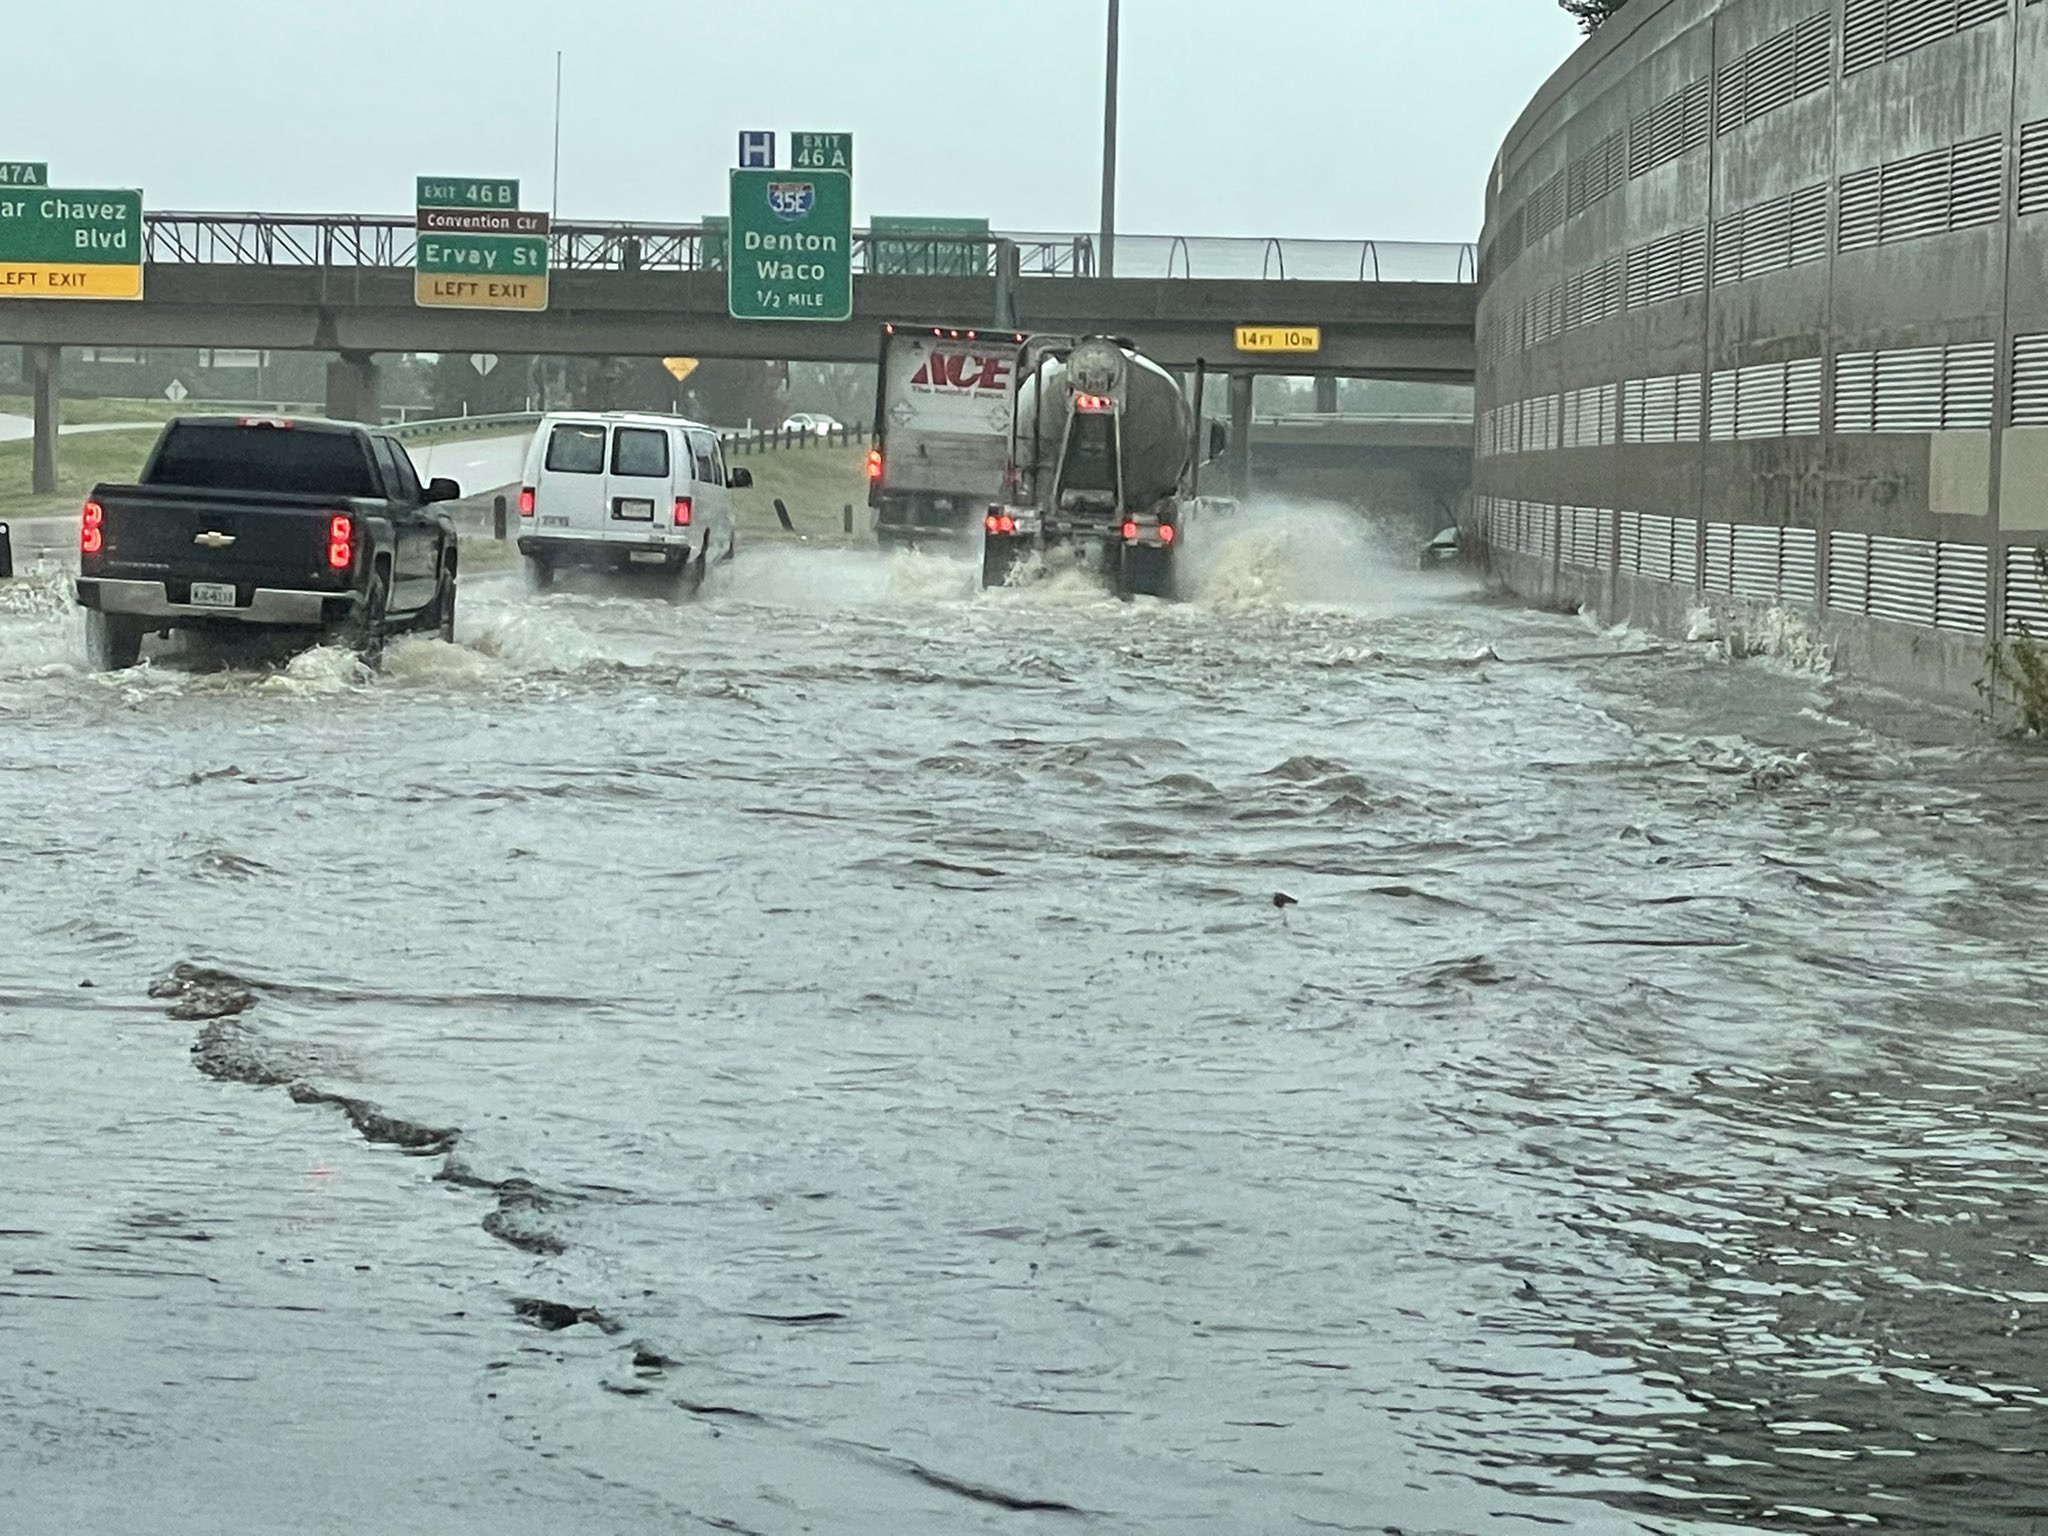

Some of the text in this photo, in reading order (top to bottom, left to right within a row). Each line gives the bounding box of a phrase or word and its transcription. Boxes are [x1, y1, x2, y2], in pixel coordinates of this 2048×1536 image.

[743, 133, 771, 167] H
[802, 135, 840, 148] EXIT
[797, 149, 846, 167] 46 A
[424, 185, 512, 203] EXIT 46 B
[772, 190, 807, 213] 35E
[40, 199, 127, 220] Chavez
[427, 213, 538, 229] Convention Ctr
[75, 228, 126, 248] Blvd
[745, 231, 837, 252] Denton
[425, 244, 538, 270] Ervay St
[48, 272, 87, 287] EXIT
[757, 261, 825, 280] Waco
[434, 281, 528, 298] LEFT EXIT
[788, 293, 823, 306] MILE
[910, 352, 1010, 390] ACE
